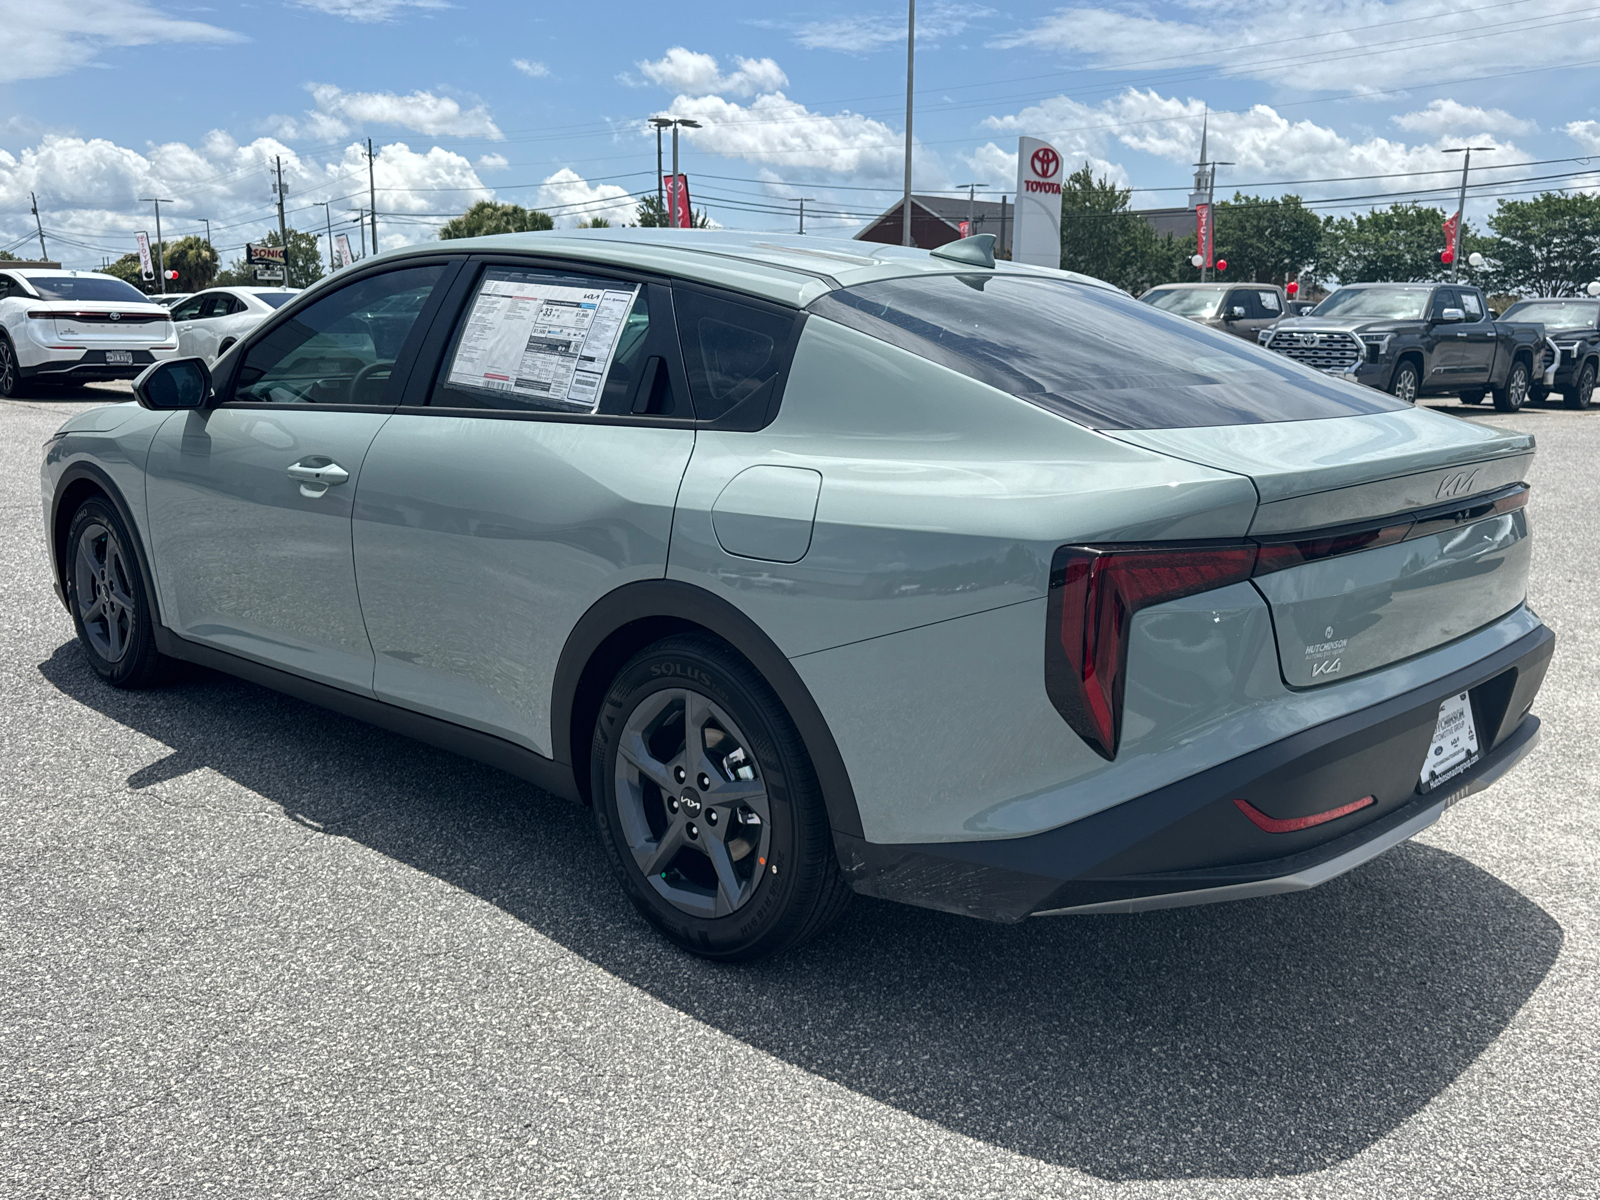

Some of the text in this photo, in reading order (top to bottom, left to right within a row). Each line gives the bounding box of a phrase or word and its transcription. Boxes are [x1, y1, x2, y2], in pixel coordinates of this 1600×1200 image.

[1025, 180, 1061, 195] TOYOTA
[252, 248, 284, 258] SONIC
[543, 307, 553, 317] 33
[1435, 468, 1480, 499] KIA
[1305, 638, 1348, 655] HUTCHINSON
[650, 661, 712, 686] SOLUS
